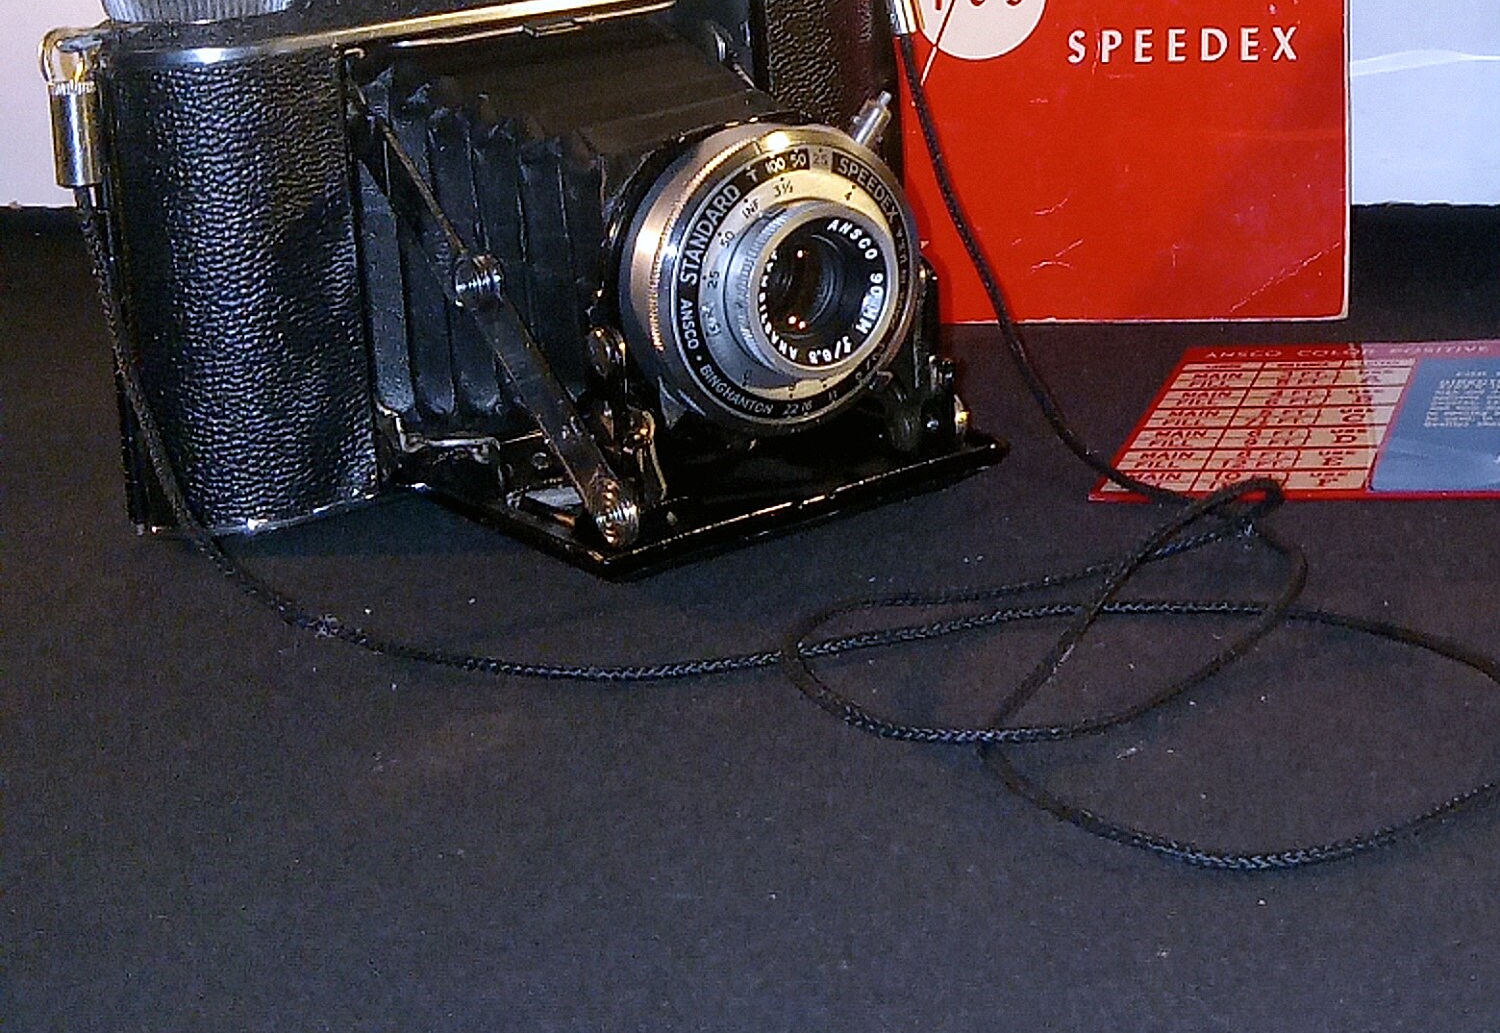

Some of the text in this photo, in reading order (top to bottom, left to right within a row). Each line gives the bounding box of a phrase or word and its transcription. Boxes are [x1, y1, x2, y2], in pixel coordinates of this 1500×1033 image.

[1068, 26, 1297, 64] SPEEDEX
[765, 156, 786, 174] 100
[789, 153, 807, 167] 50
[838, 156, 899, 225] SPEEDEX
[679, 184, 741, 286] STANDARD
[827, 219, 878, 260] ANSCO
[707, 270, 720, 289] 25
[680, 298, 699, 349] ANSCO
